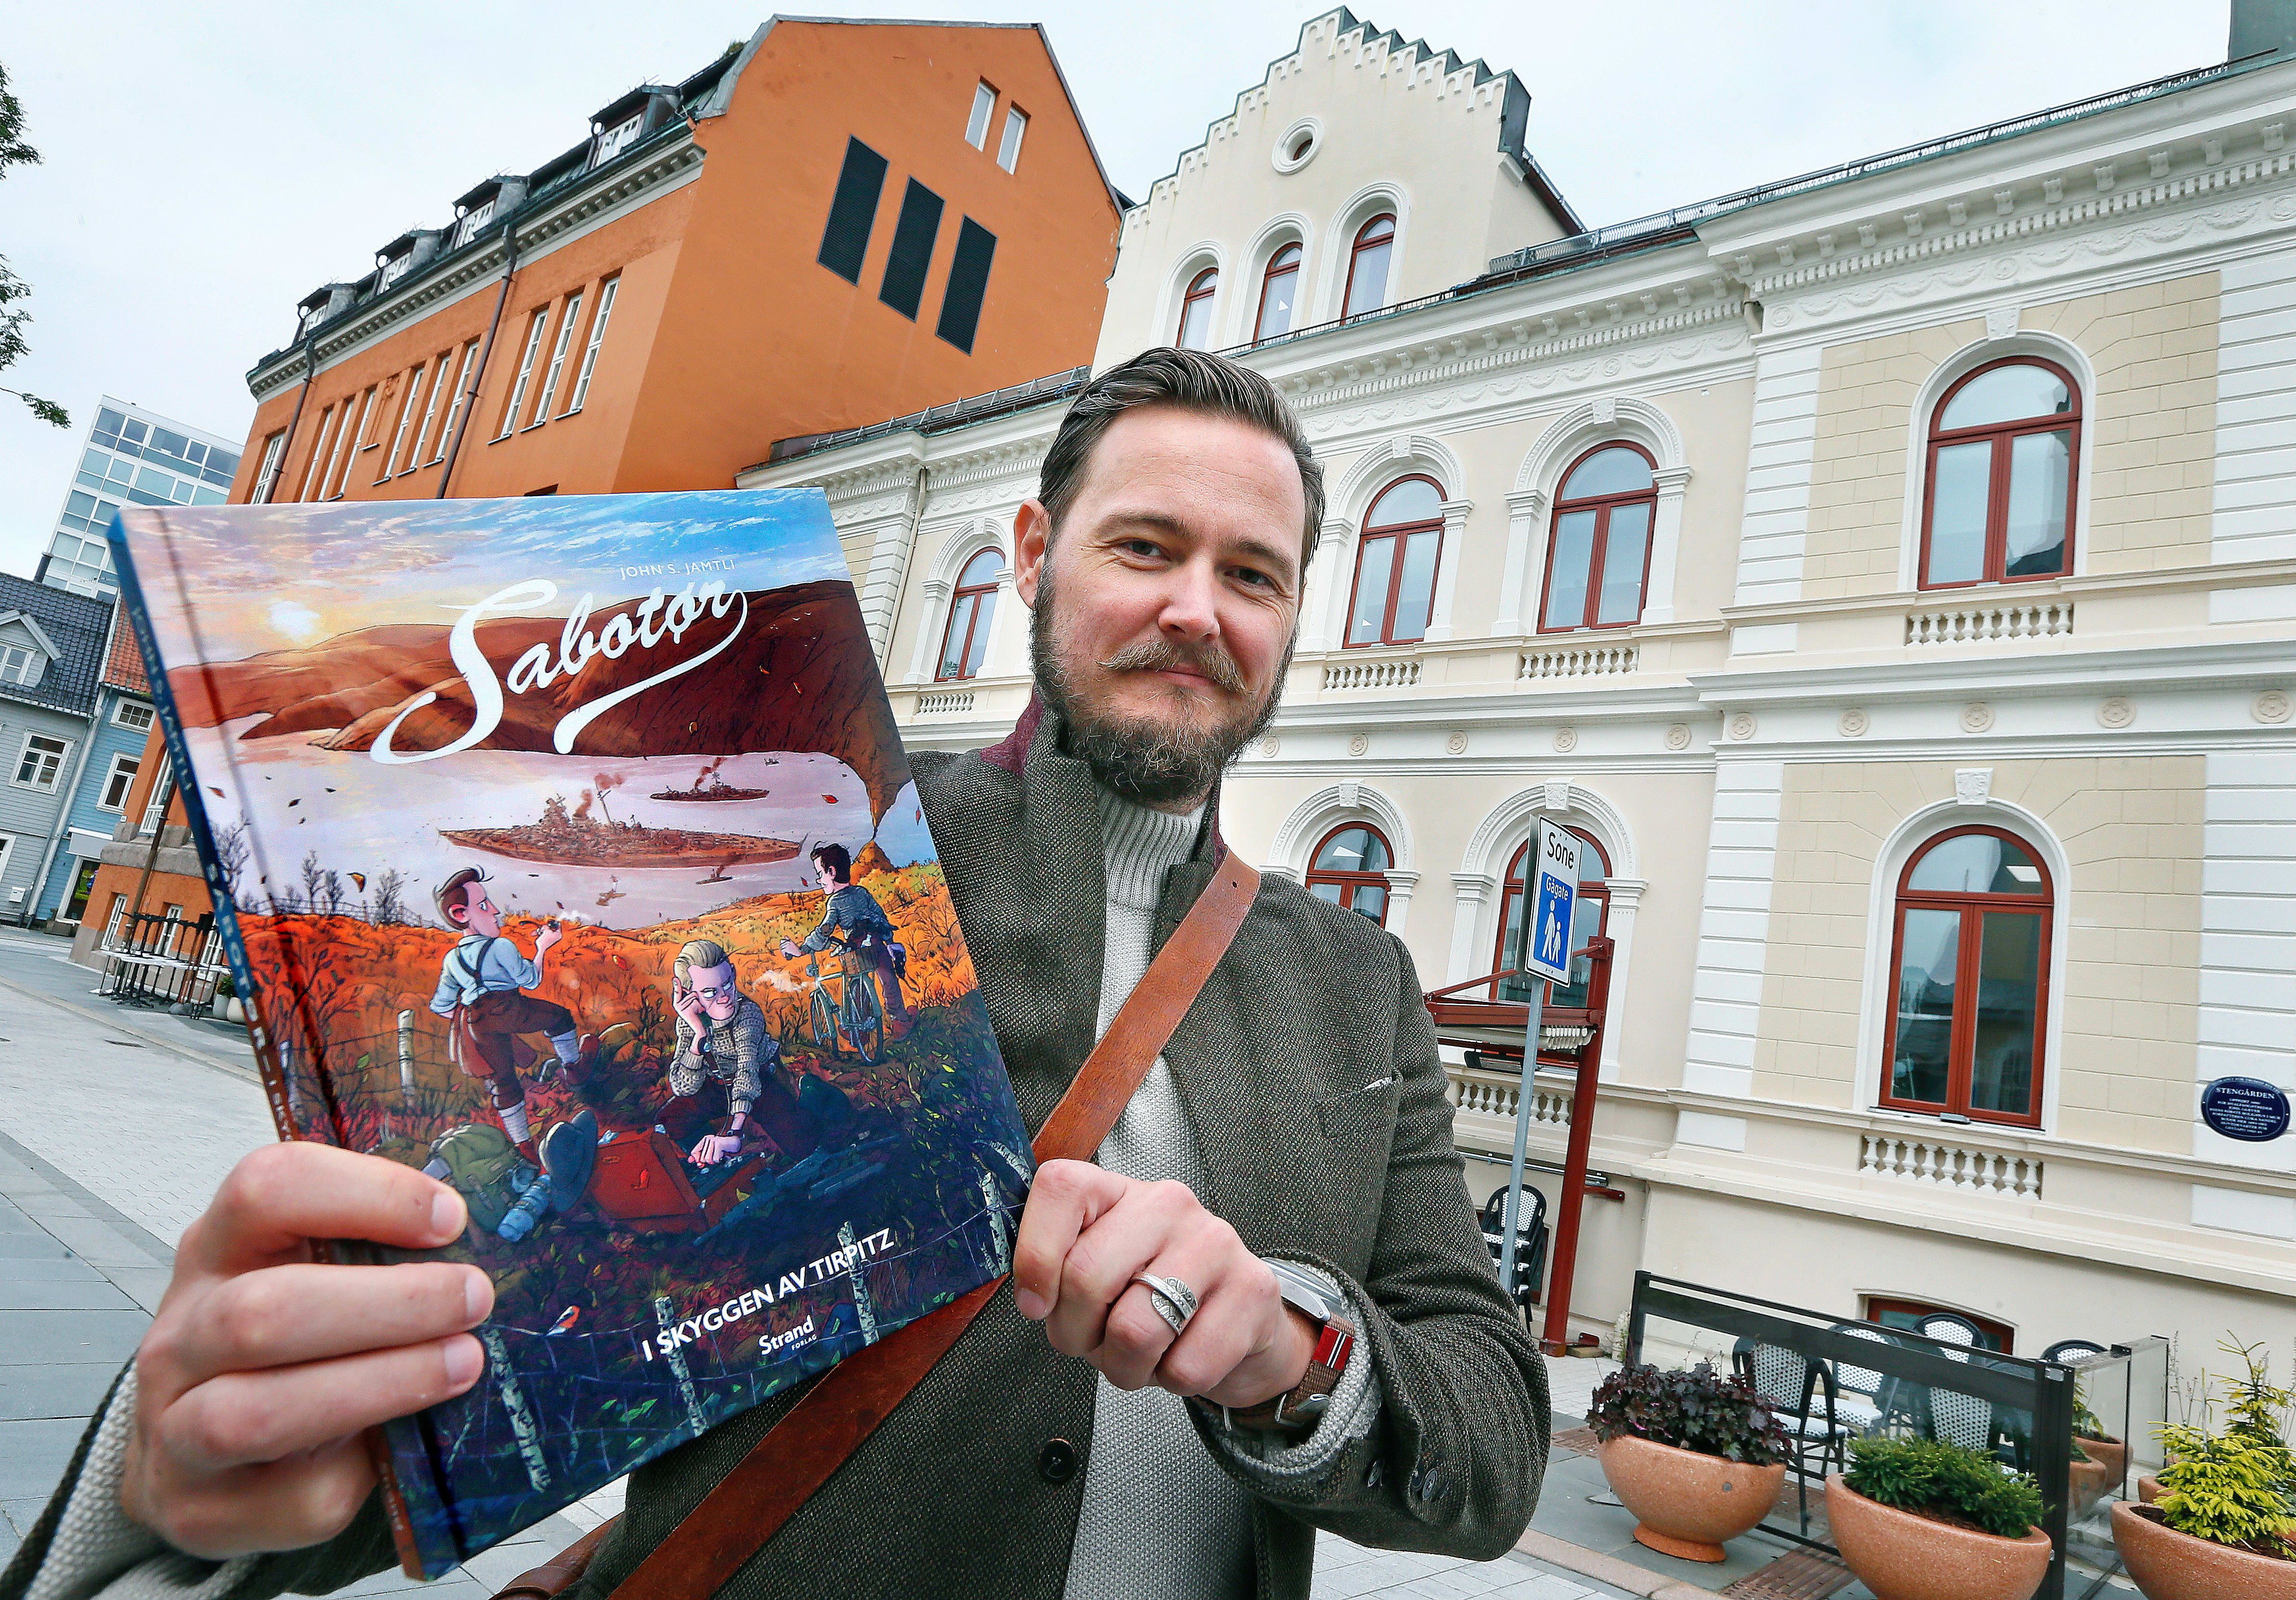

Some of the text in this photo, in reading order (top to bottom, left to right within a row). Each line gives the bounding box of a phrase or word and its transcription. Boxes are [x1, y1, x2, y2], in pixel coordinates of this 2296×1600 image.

[620, 559, 736, 581] JOHN S. JAMTLI
[369, 578, 749, 765] Sabotør
[1547, 832, 1574, 870] Sone
[1546, 876, 1568, 901] Gågate
[2216, 1087, 2274, 1099] STENGÅRDEN
[642, 1227, 895, 1362] I SKYGGEN AV TIRPITZ
[759, 1314, 815, 1356] Strand
[791, 1334, 818, 1350] FORLAG
